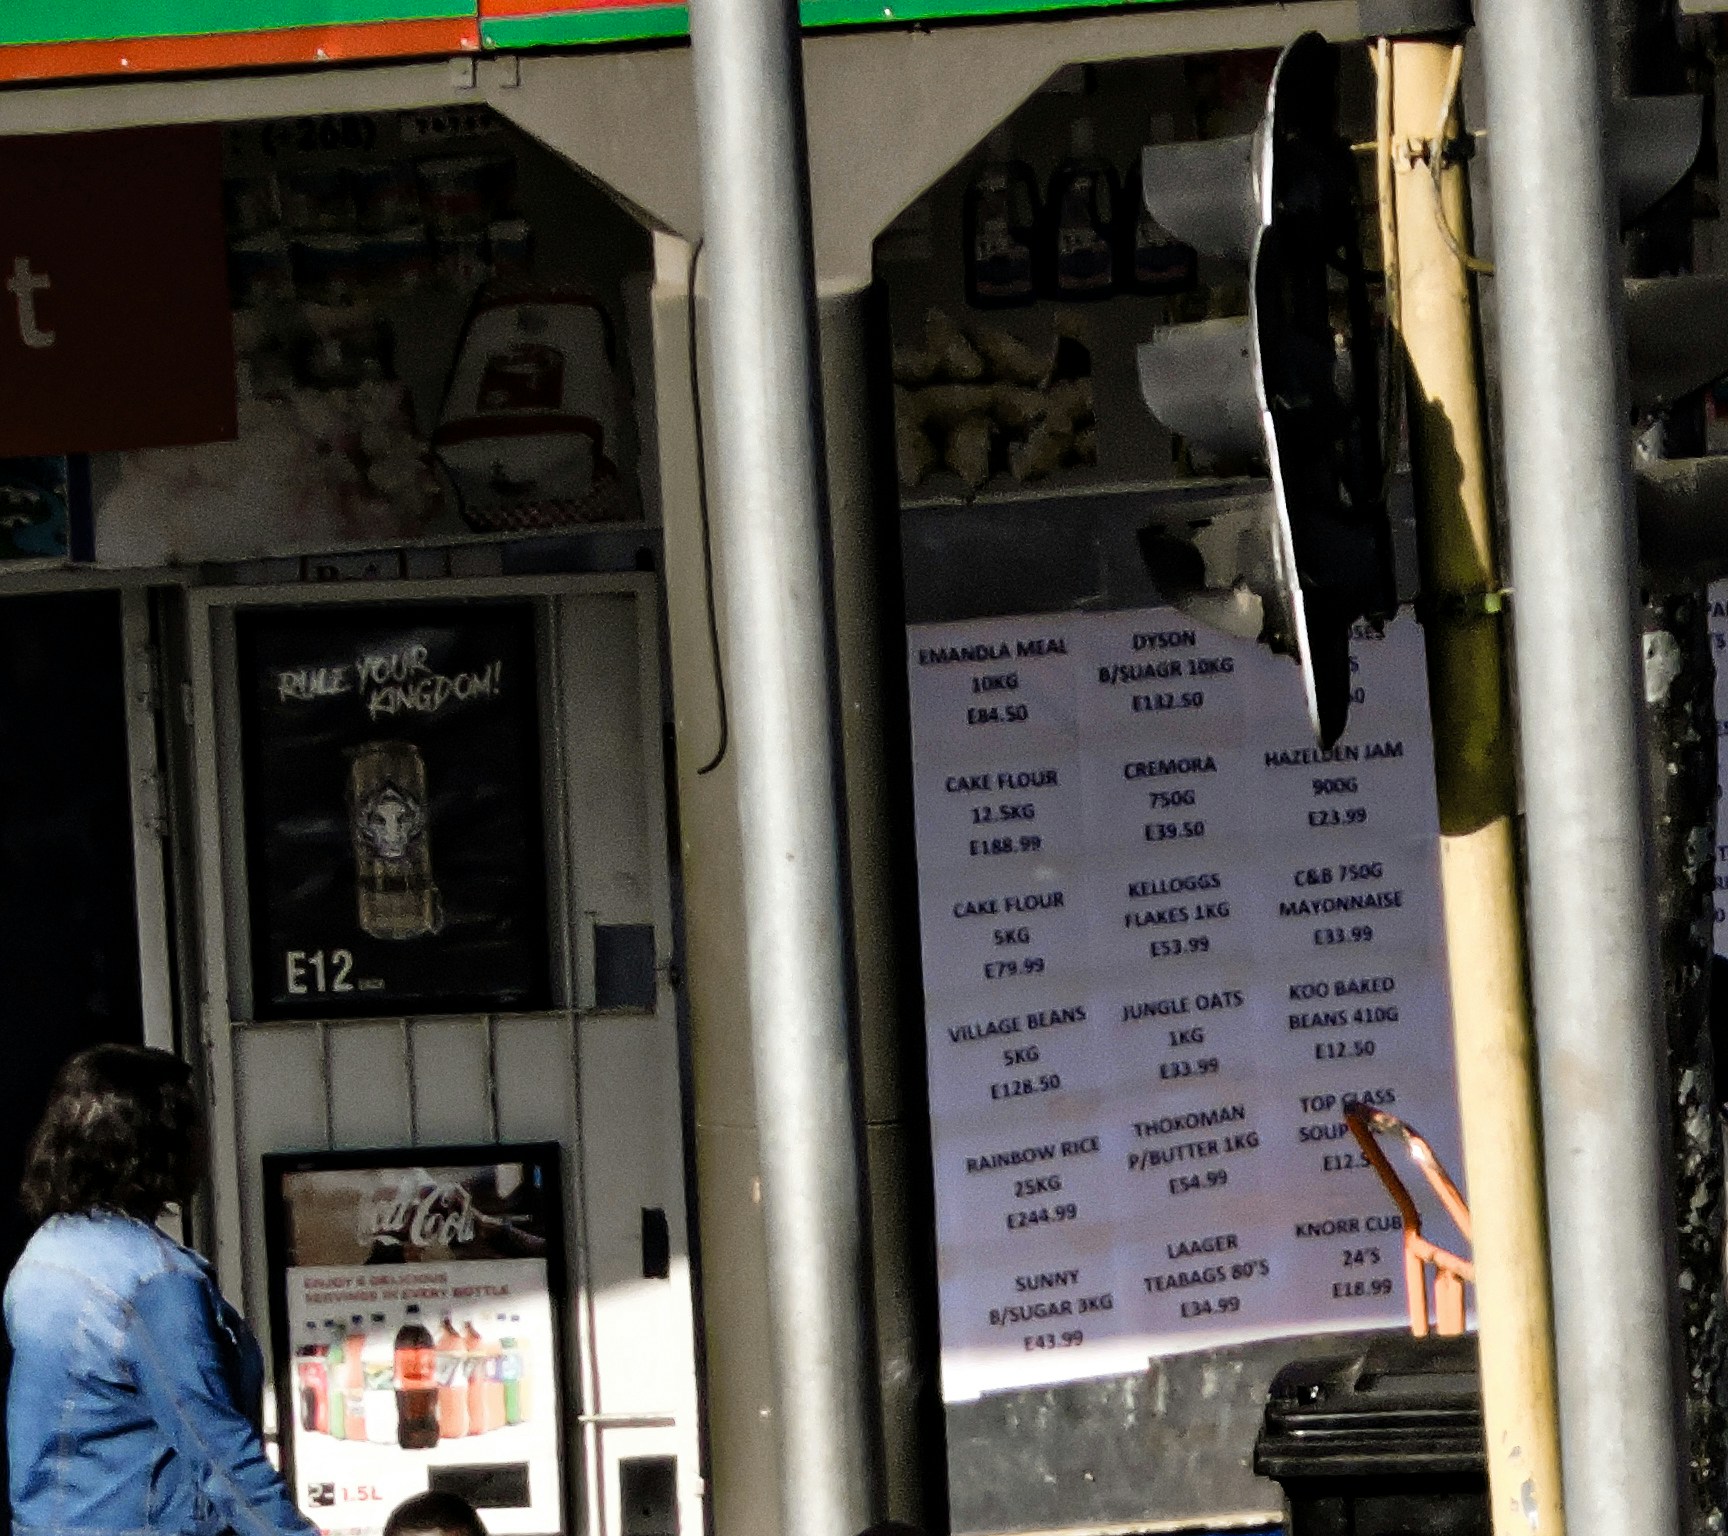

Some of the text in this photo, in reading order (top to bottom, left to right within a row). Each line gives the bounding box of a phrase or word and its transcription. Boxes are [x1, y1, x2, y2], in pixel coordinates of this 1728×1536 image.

[918, 638, 1068, 666] EMANDLA MEAL
[1132, 630, 1196, 650] DYSON
[276, 644, 432, 703] RULE YOUR
[1099, 656, 1235, 684] B/SUAGR 10KG
[367, 658, 503, 722] KINGDOM!
[972, 673, 1019, 693] 10KG
[967, 704, 1029, 725] E84.50
[1364, 741, 1404, 761] JAM
[1123, 756, 1218, 780] CREMORA
[945, 769, 1058, 792] CAKE FLOUR
[1312, 776, 1359, 796] 900G
[1149, 789, 1196, 809] 750G
[971, 803, 1036, 824] 12.5KG
[1308, 806, 1368, 827] E23.99
[1144, 820, 1205, 842] E39.50
[1128, 872, 1221, 898] KELLOGGS
[1294, 861, 1384, 887] C&B 750G
[952, 891, 1064, 918] CAKE FLOUR
[1124, 901, 1230, 929] FLAKES 1KG
[1279, 889, 1404, 917] MAYONNAISE
[993, 926, 1031, 946] 5KG
[1150, 935, 1210, 958] E53.99
[1313, 925, 1374, 946] E33.99
[285, 947, 356, 994] E12
[983, 957, 1046, 980] E79.99
[1289, 976, 1395, 1001] KOO BAKED
[1121, 989, 1245, 1022] JUNGLE OATS
[947, 1005, 1087, 1043] VILLAGE BEANS
[1289, 1006, 1400, 1030] BEANS 410G
[1168, 1026, 1205, 1047] 1KG
[1003, 1044, 1040, 1067] 5KG
[1314, 1039, 1376, 1060] E12.50
[1159, 1057, 1220, 1080] E33.99
[990, 1073, 1061, 1100] E128.50
[1299, 1095, 1336, 1113] TOP
[1133, 1103, 1246, 1137] THOKOMAN
[1299, 1123, 1349, 1142] SOUP
[966, 1135, 1102, 1174] RAINBOW RICE
[1127, 1130, 1261, 1171] P/BUTTER 1KG
[1322, 1152, 1372, 1172] E12.5
[1013, 1174, 1063, 1198] 25KG
[1168, 1168, 1229, 1194] E54.99
[1006, 1203, 1079, 1230] E244.99
[1295, 1214, 1404, 1238] KNORR CUB
[1166, 1233, 1239, 1259] LAAGER
[1014, 1269, 1080, 1292] SUNNY
[1143, 1264, 1227, 1294] TEABAGS
[1331, 1278, 1393, 1299] E18.99
[988, 1292, 1114, 1327] B/SUGAR 3KG
[1180, 1295, 1241, 1319] E34.99
[1023, 1329, 1085, 1351] E43.99
[341, 1484, 383, 1502] 1.5L
